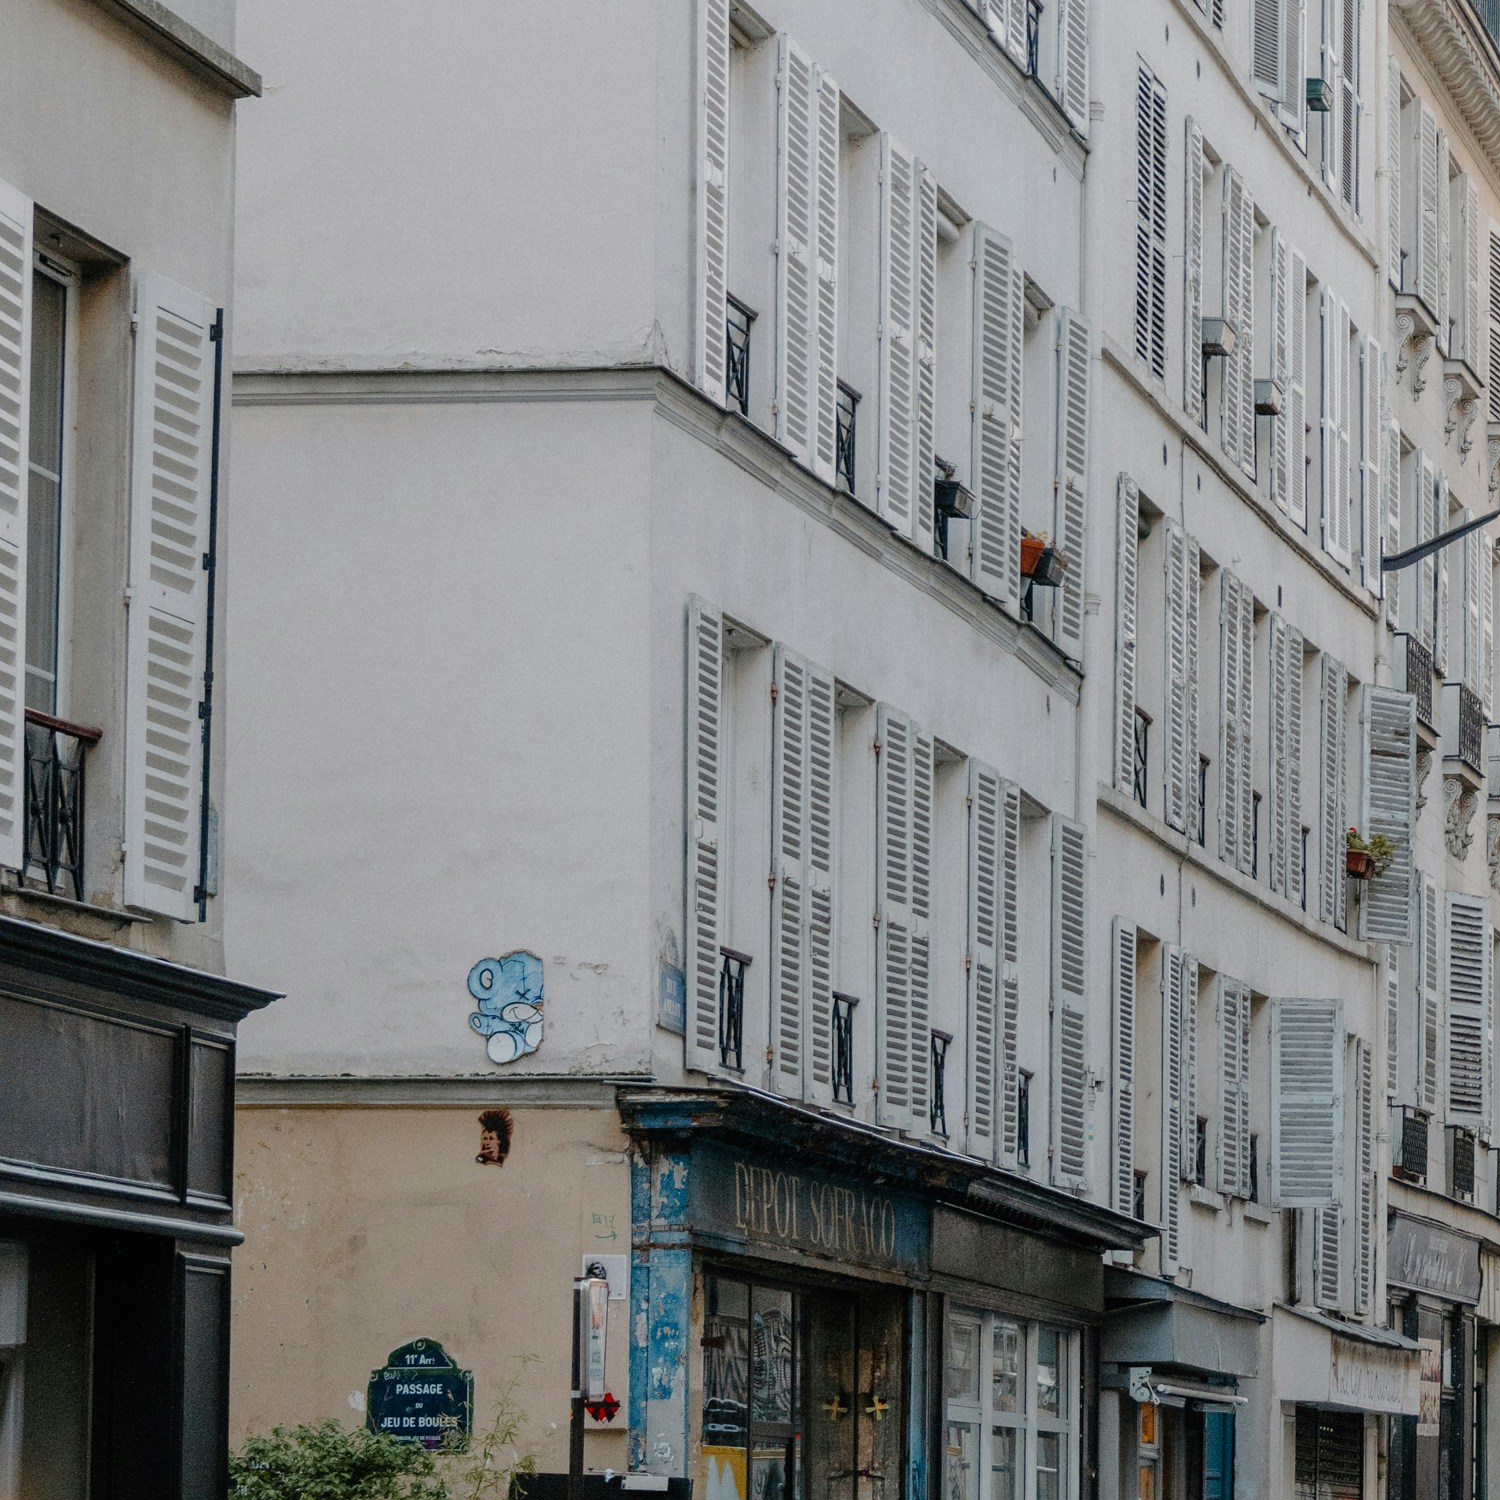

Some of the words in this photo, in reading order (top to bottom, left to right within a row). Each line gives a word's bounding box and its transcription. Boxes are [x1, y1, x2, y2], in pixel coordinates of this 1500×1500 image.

[396, 1383, 443, 1395] PASSAGE
[381, 1417, 400, 1428] JEU
[402, 1417, 416, 1428] DE
[418, 1416, 458, 1428] BOULES
